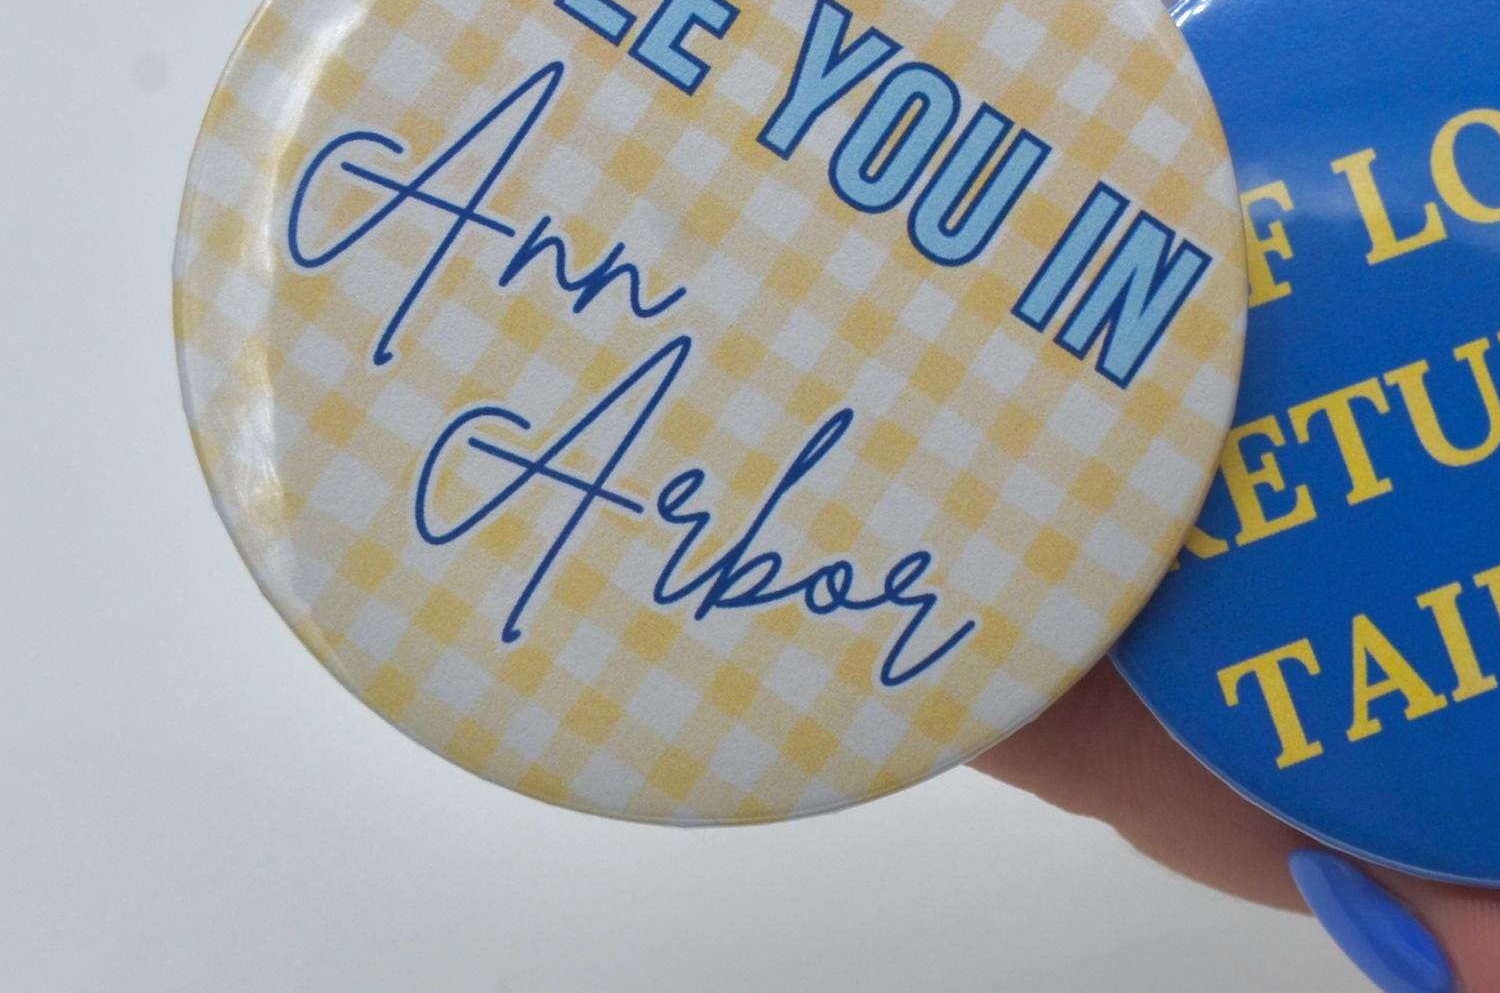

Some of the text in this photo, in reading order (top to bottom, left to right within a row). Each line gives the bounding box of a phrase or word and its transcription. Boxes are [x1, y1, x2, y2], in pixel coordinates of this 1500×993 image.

[288, 61, 686, 365] Ann
[1011, 181, 1213, 389] IN
[1239, 178, 1295, 310] F
[414, 335, 976, 686] Arbor
